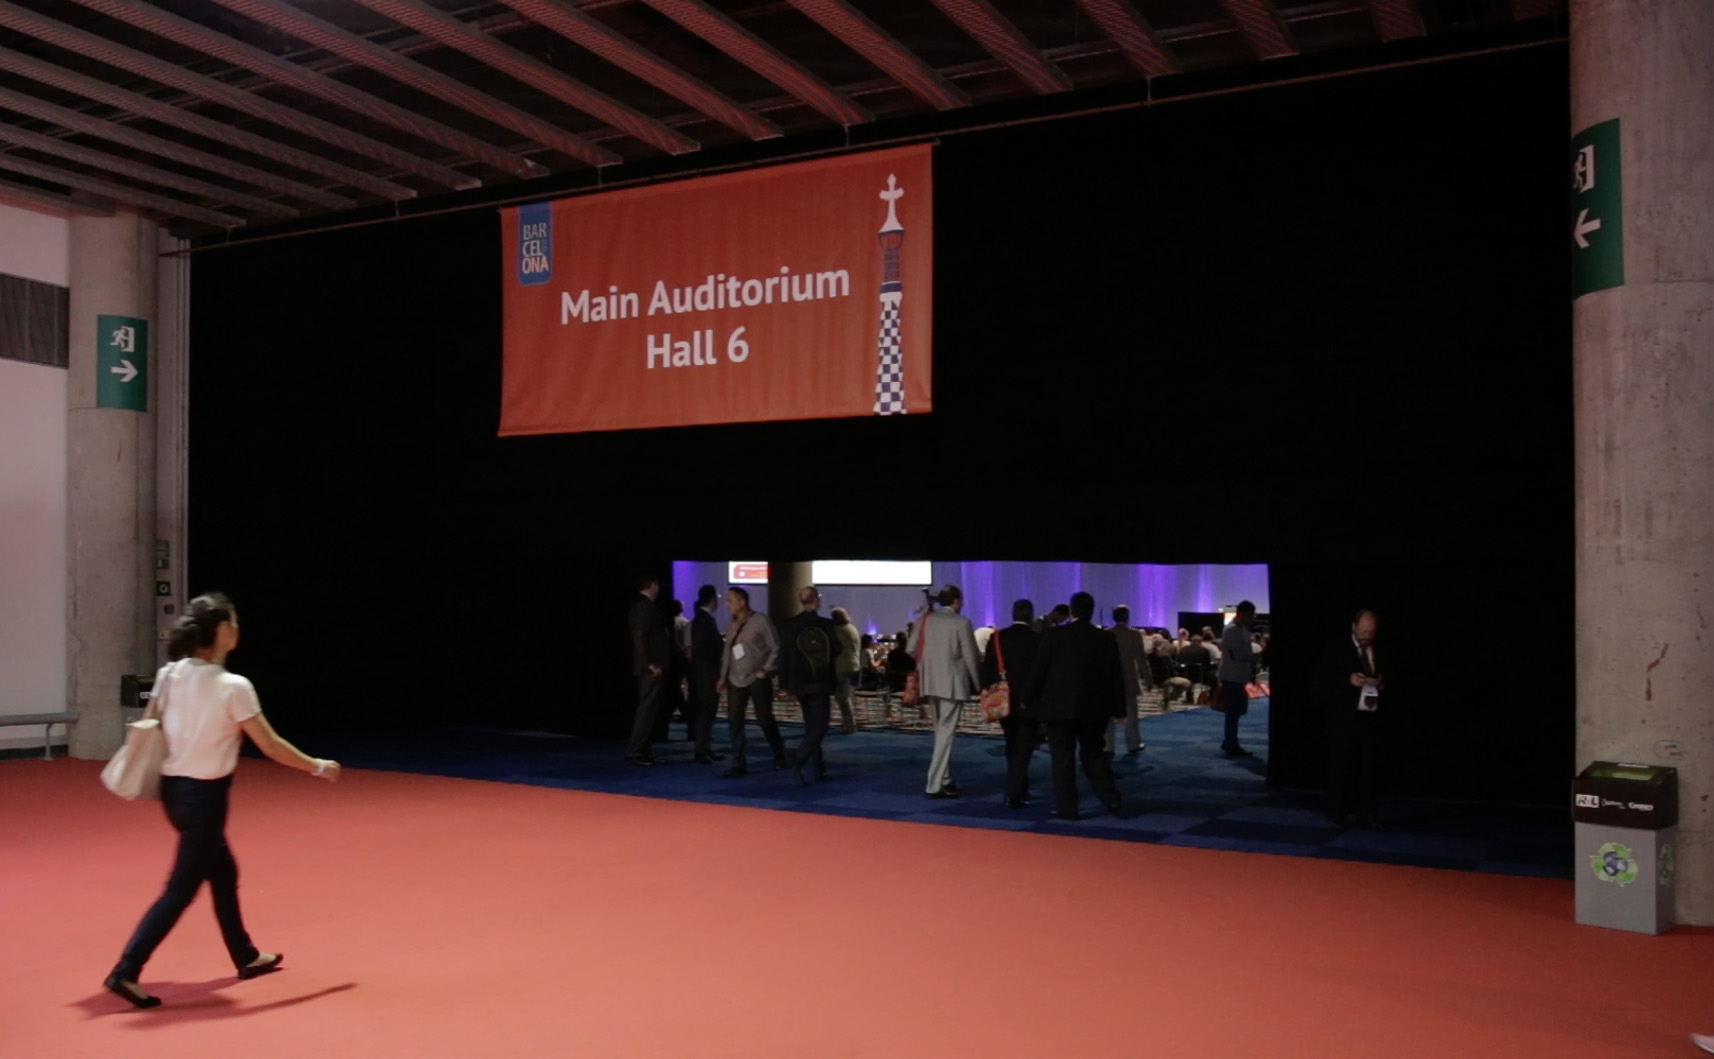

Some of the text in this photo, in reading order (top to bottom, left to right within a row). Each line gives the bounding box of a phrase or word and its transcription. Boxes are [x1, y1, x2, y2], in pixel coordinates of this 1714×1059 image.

[523, 222, 547, 241] BAR
[522, 239, 544, 257] CEL
[522, 255, 549, 274] ONA
[562, 266, 849, 324] Main Auditorium
[647, 326, 749, 369] Hall 6
